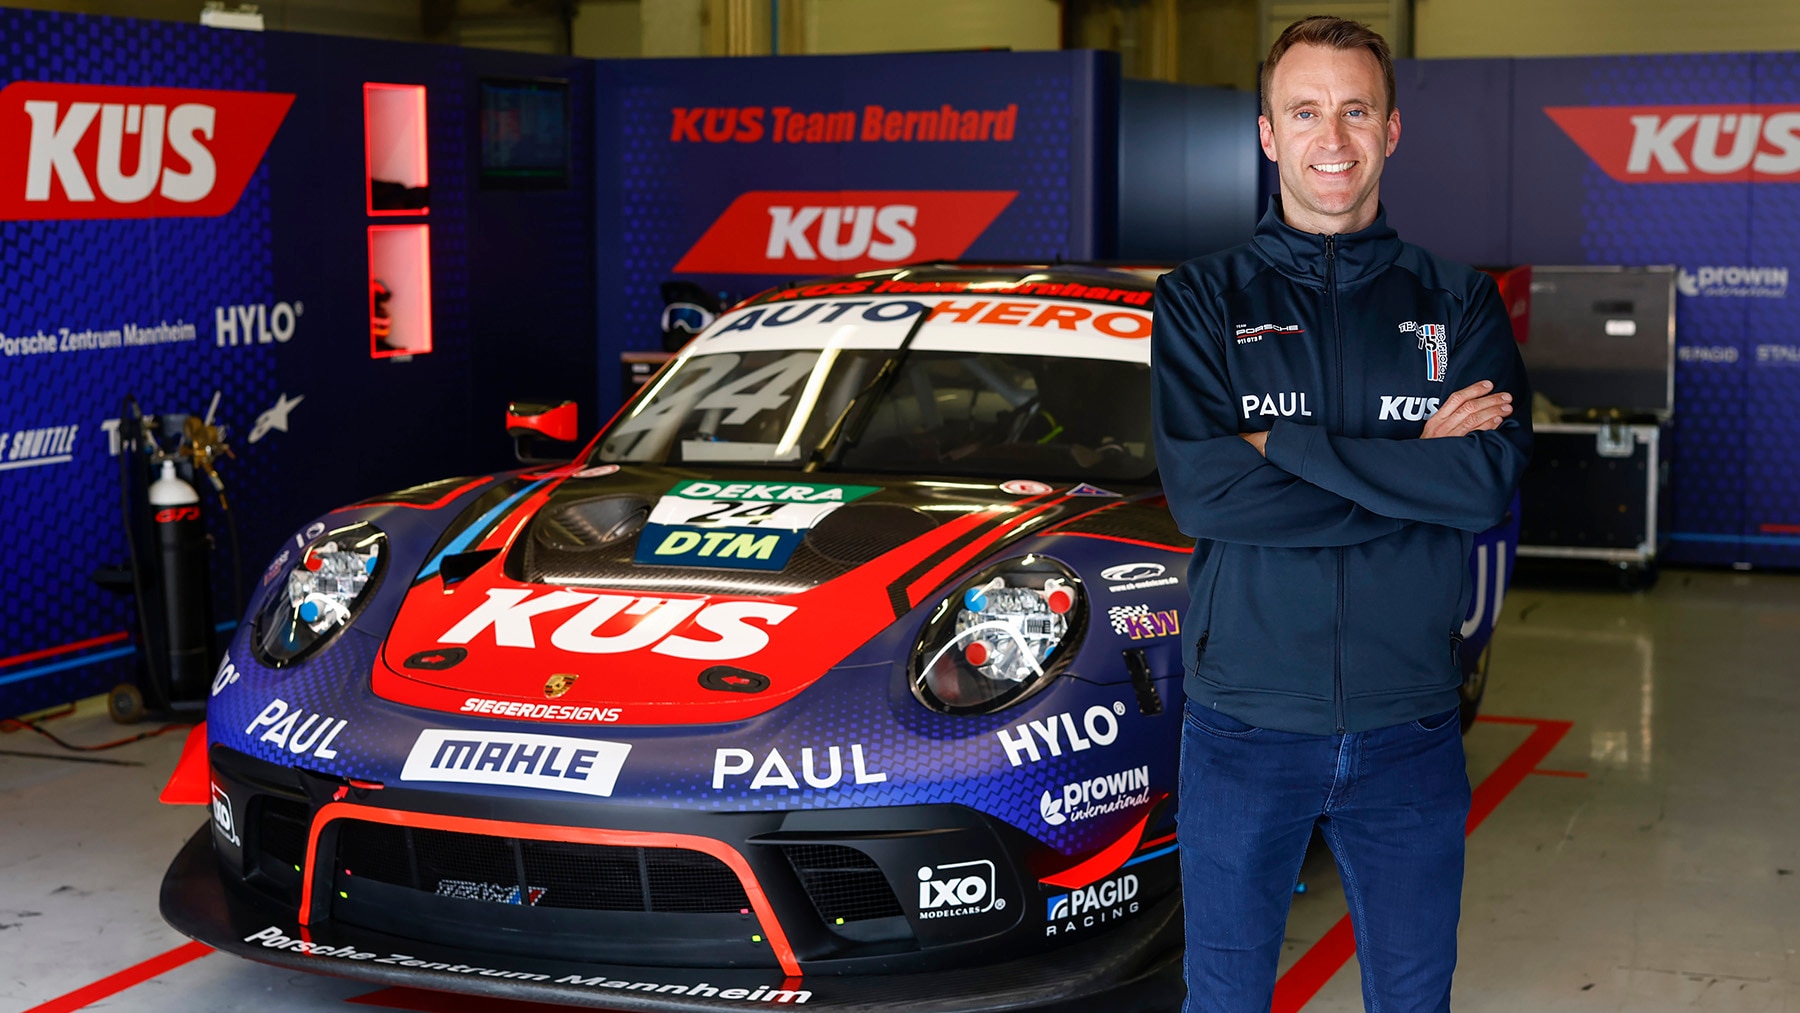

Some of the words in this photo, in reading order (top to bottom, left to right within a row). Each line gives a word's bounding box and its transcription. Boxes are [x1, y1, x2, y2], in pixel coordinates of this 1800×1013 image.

[670, 107, 765, 142] KÜS
[772, 107, 856, 142] Team
[860, 104, 1019, 141] Bernhard
[24, 100, 217, 203] KÜS
[1626, 112, 1800, 174] KÜS
[766, 205, 918, 261] KÜS
[58, 327, 122, 352] Zentrum
[123, 318, 197, 347] Mannheim
[1236, 324, 1299, 336] PORSCHE
[1436, 324, 1448, 382] MOTORSPORT
[1241, 392, 1312, 419] PAUL
[1379, 395, 1440, 421] KÜS
[9, 424, 79, 461] SHUTTLE
[680, 482, 843, 501] DEKRA
[686, 501, 789, 526] 24
[655, 531, 780, 560] DTM
[437, 588, 798, 660] KÜS
[1125, 609, 1180, 640] KW
[460, 697, 623, 722] SIEGERDESIGNS
[245, 698, 348, 760] PAUL
[430, 739, 599, 781] MAHLE
[712, 743, 887, 790] PAUL
[1071, 786, 1150, 822] international
[919, 906, 981, 920] MODELCARS
[1071, 874, 1139, 916] PAGID
[1046, 902, 1140, 936] RACING
[244, 926, 377, 960] Porsche
[374, 953, 552, 981] Zentrum
[554, 974, 813, 1004] Mannheim
